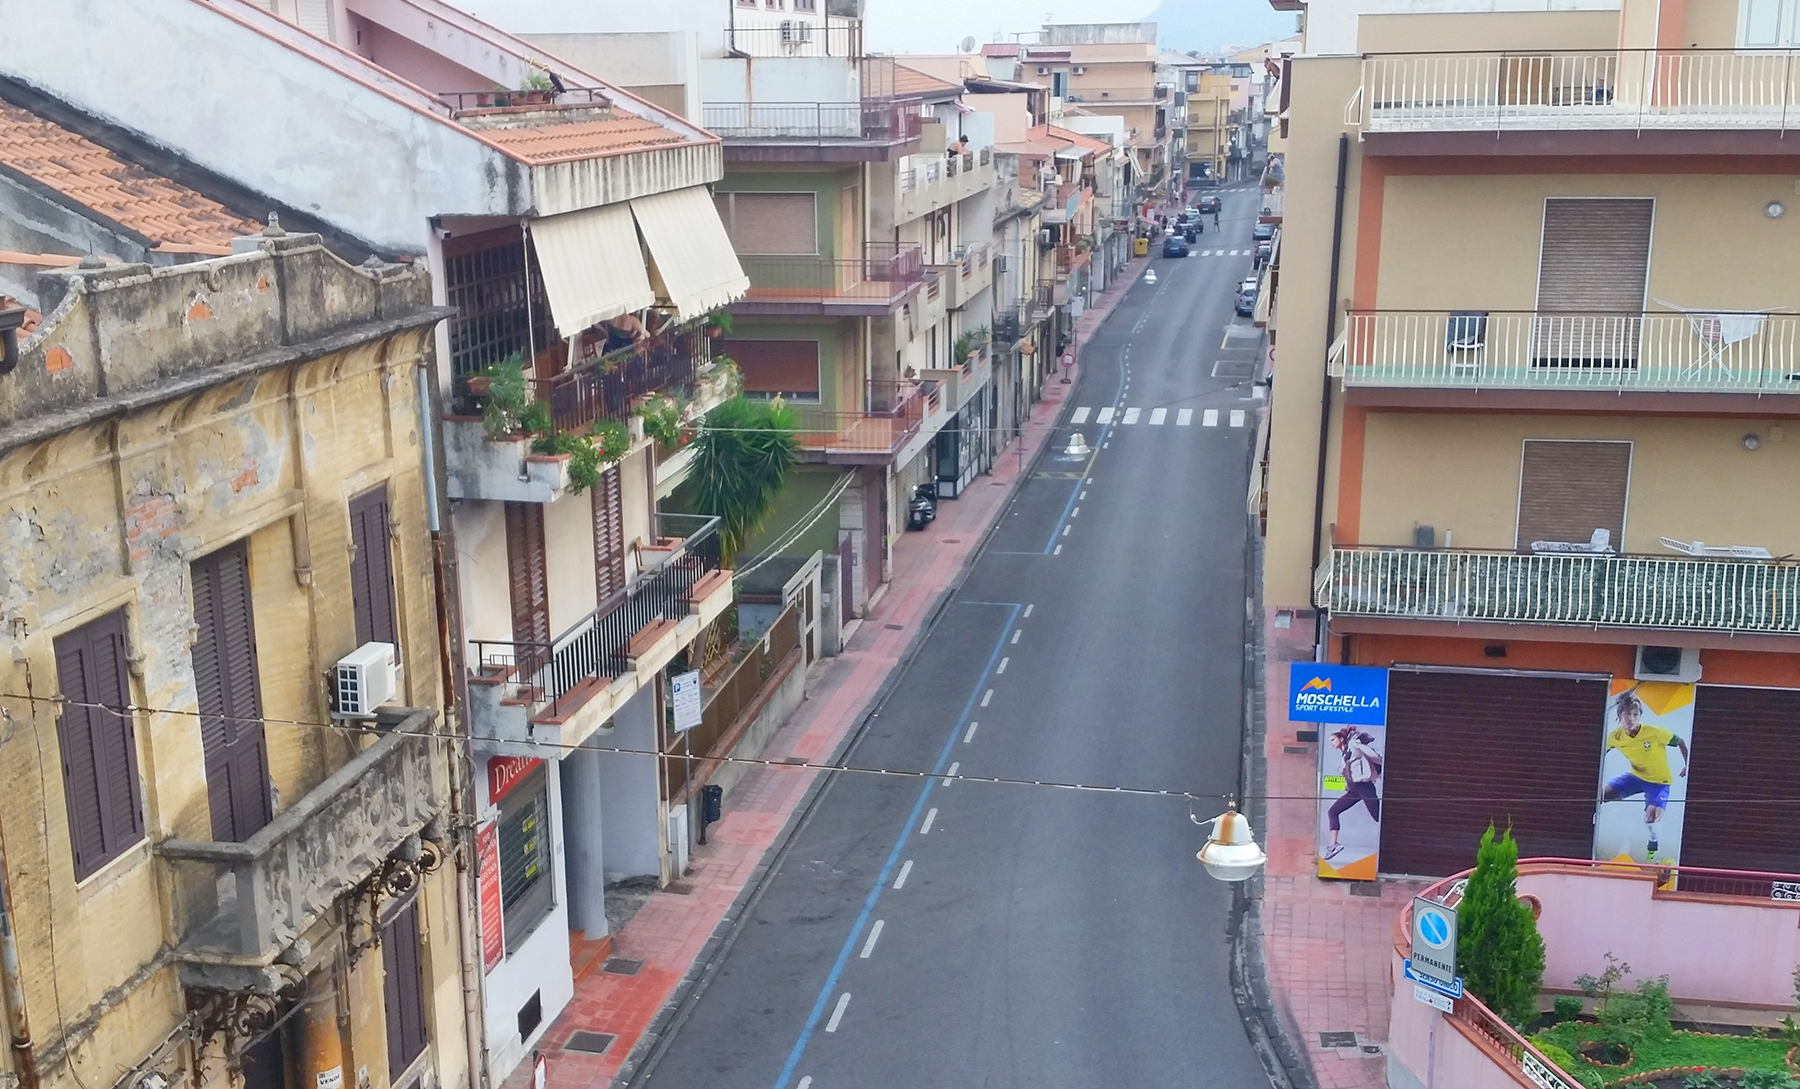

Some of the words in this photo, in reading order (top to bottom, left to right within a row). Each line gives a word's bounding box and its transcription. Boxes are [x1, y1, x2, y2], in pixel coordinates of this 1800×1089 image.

[1295, 692, 1380, 708] MOSCHELLA
[1319, 705, 1354, 713] LIFESTYLE
[1413, 952, 1452, 973] PERMANENTE
